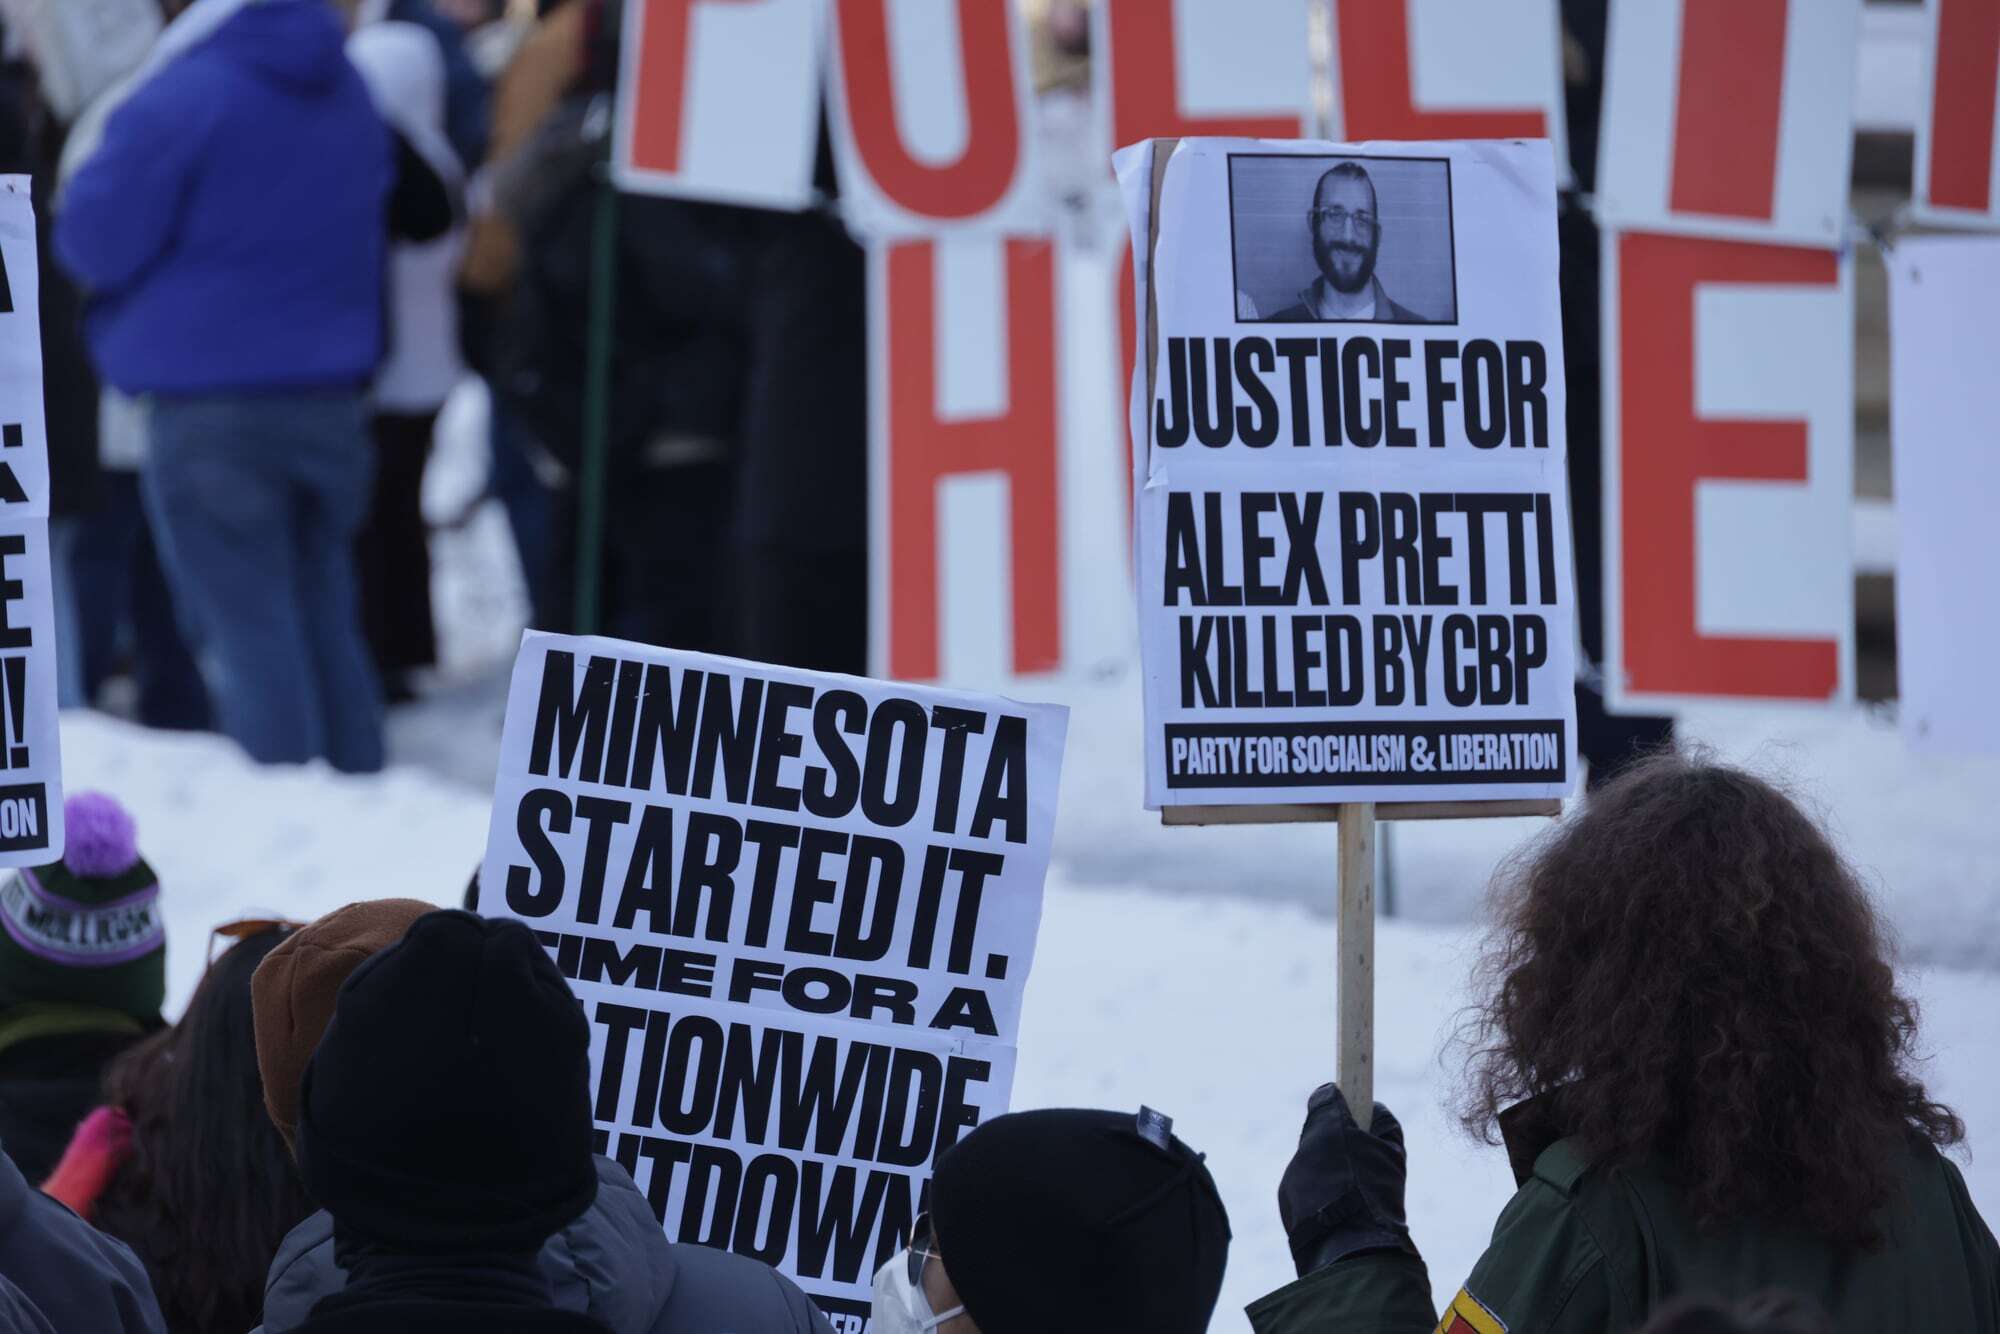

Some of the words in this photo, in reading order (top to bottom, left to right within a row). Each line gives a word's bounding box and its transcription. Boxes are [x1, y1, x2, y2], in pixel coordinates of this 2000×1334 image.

[1156, 336, 1417, 448] JUSTICE
[1424, 338, 1549, 449] FOR
[1163, 491, 1330, 607] ALEX
[1339, 491, 1557, 606] PRETTI
[1179, 614, 1364, 708] KILLED
[1372, 614, 1433, 707] BY
[1442, 613, 1547, 707] CBP
[528, 649, 1028, 844] MINNESOTA
[1171, 736, 1241, 775] PARTY
[1246, 735, 1288, 774] FOR
[1291, 734, 1406, 774] SOCIALISM
[1411, 735, 1437, 771] &
[1439, 732, 1558, 770] LIBERATION
[505, 788, 905, 962] STARTED
[906, 844, 1009, 980] IT.
[728, 957, 919, 1025] FOR
[929, 986, 998, 1037] A
[577, 999, 991, 1172] TIONWIDE
